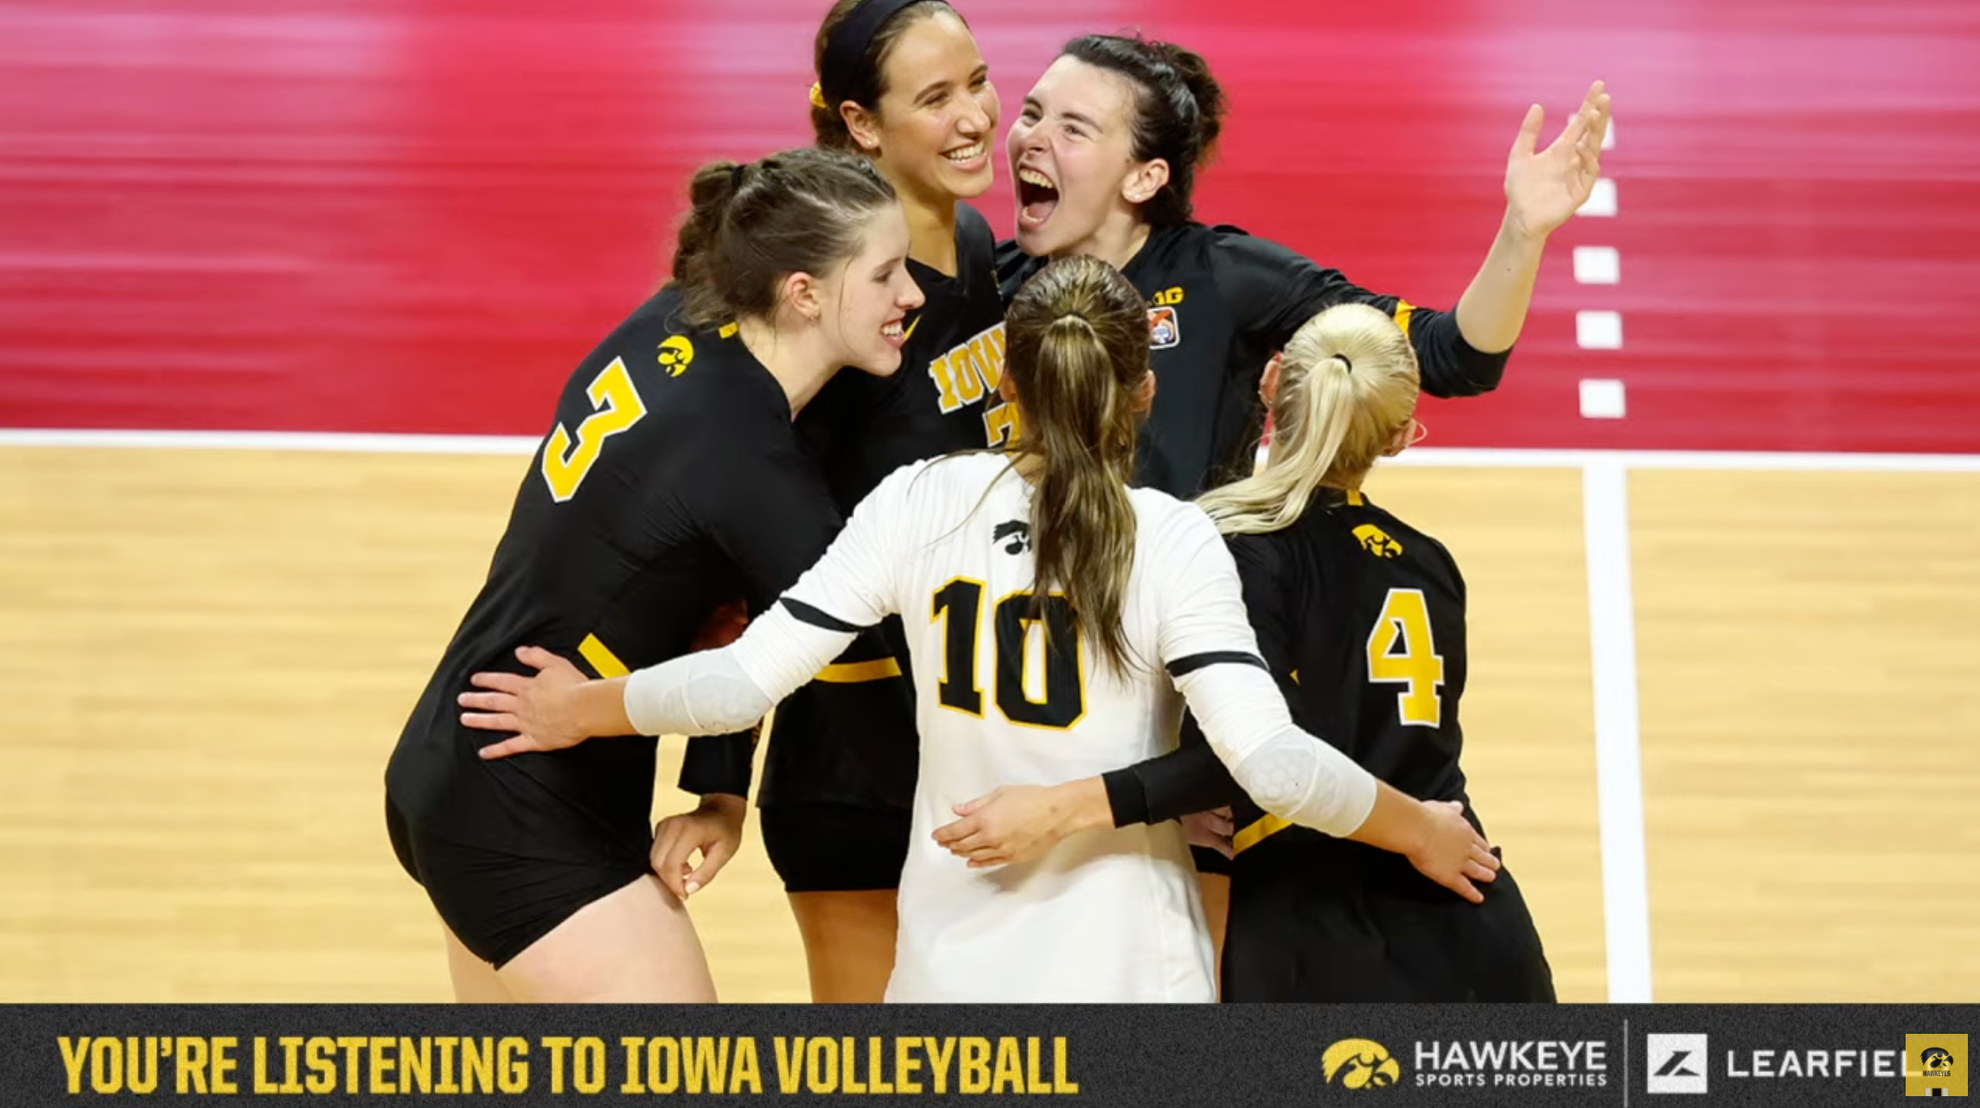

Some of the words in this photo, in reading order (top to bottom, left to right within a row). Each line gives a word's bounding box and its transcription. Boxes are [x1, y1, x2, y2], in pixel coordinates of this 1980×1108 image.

[541, 355, 648, 503] 3
[928, 320, 1007, 415] IOW
[930, 575, 1087, 731] 10
[1366, 587, 1445, 728] 4
